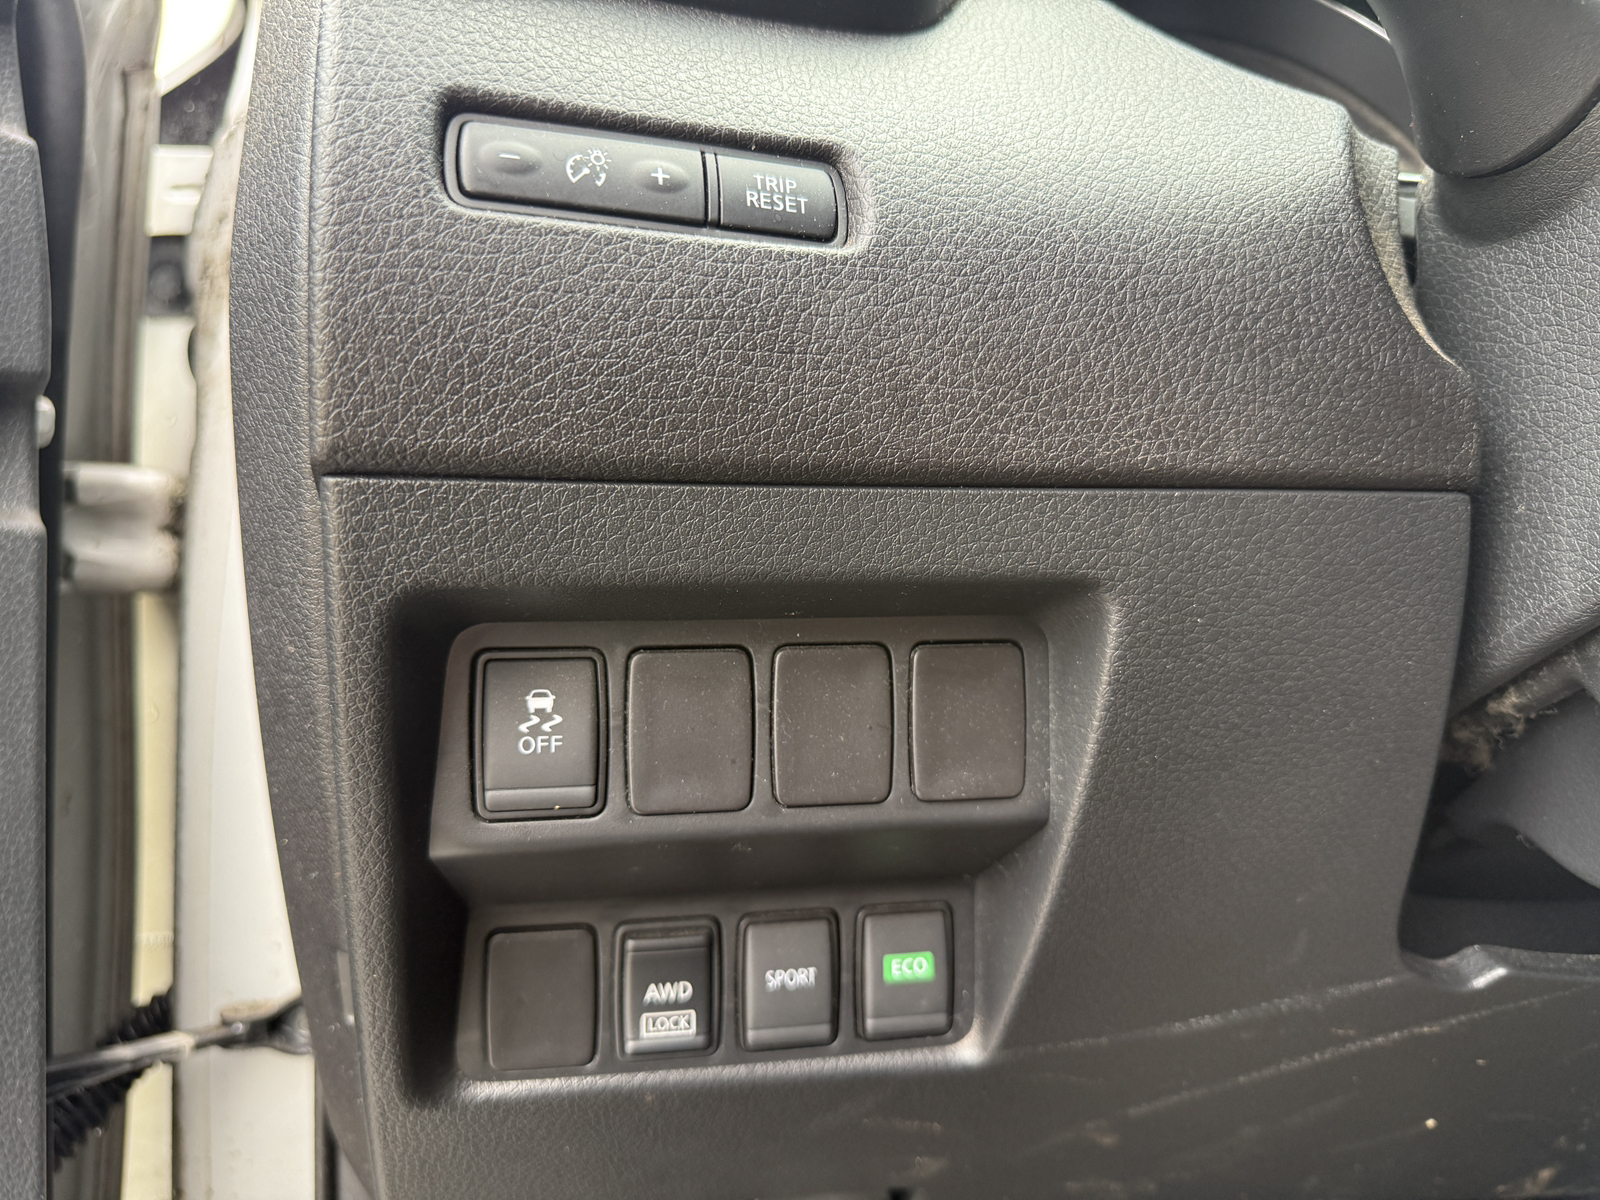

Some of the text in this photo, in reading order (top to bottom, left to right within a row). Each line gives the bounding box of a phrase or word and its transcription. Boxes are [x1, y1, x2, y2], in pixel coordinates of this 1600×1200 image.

[753, 174, 797, 194] TRIP
[746, 190, 808, 214] RESET
[518, 735, 563, 755] OFF
[891, 957, 929, 976] ECO
[766, 966, 818, 991] SPORT
[643, 981, 693, 1005] AWD
[646, 1014, 691, 1034] LOCK
